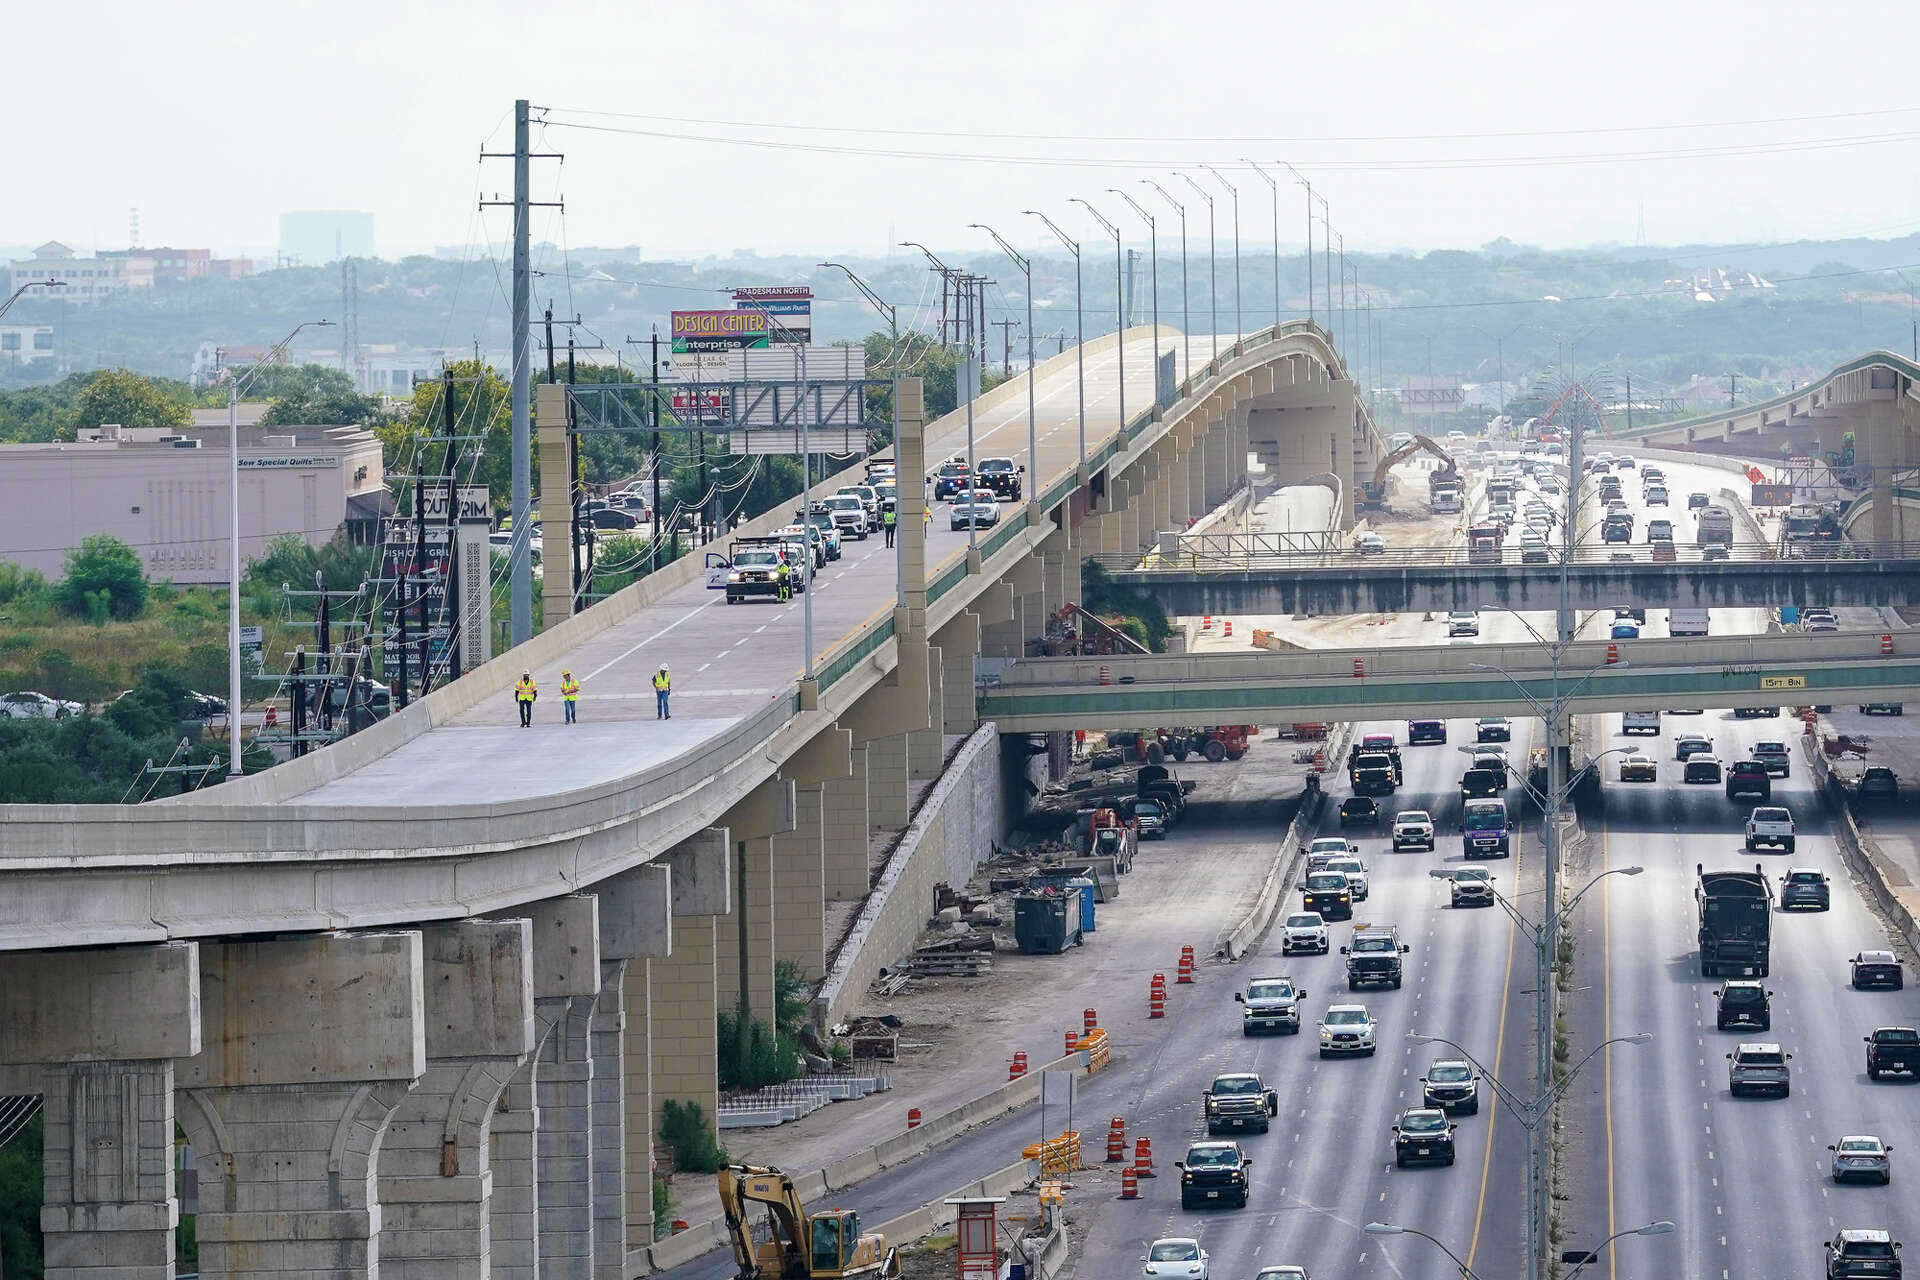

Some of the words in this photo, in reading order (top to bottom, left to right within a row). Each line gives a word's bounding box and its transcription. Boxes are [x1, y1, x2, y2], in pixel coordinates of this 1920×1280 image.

[738, 287, 781, 295] TRADESMAN
[675, 314, 719, 332] DESIGN
[721, 314, 764, 331] CENTER
[257, 458, 287, 467] Special
[289, 457, 313, 465] Quilts
[1765, 679, 1783, 688] 15FT
[1788, 678, 1801, 686] 8IN
